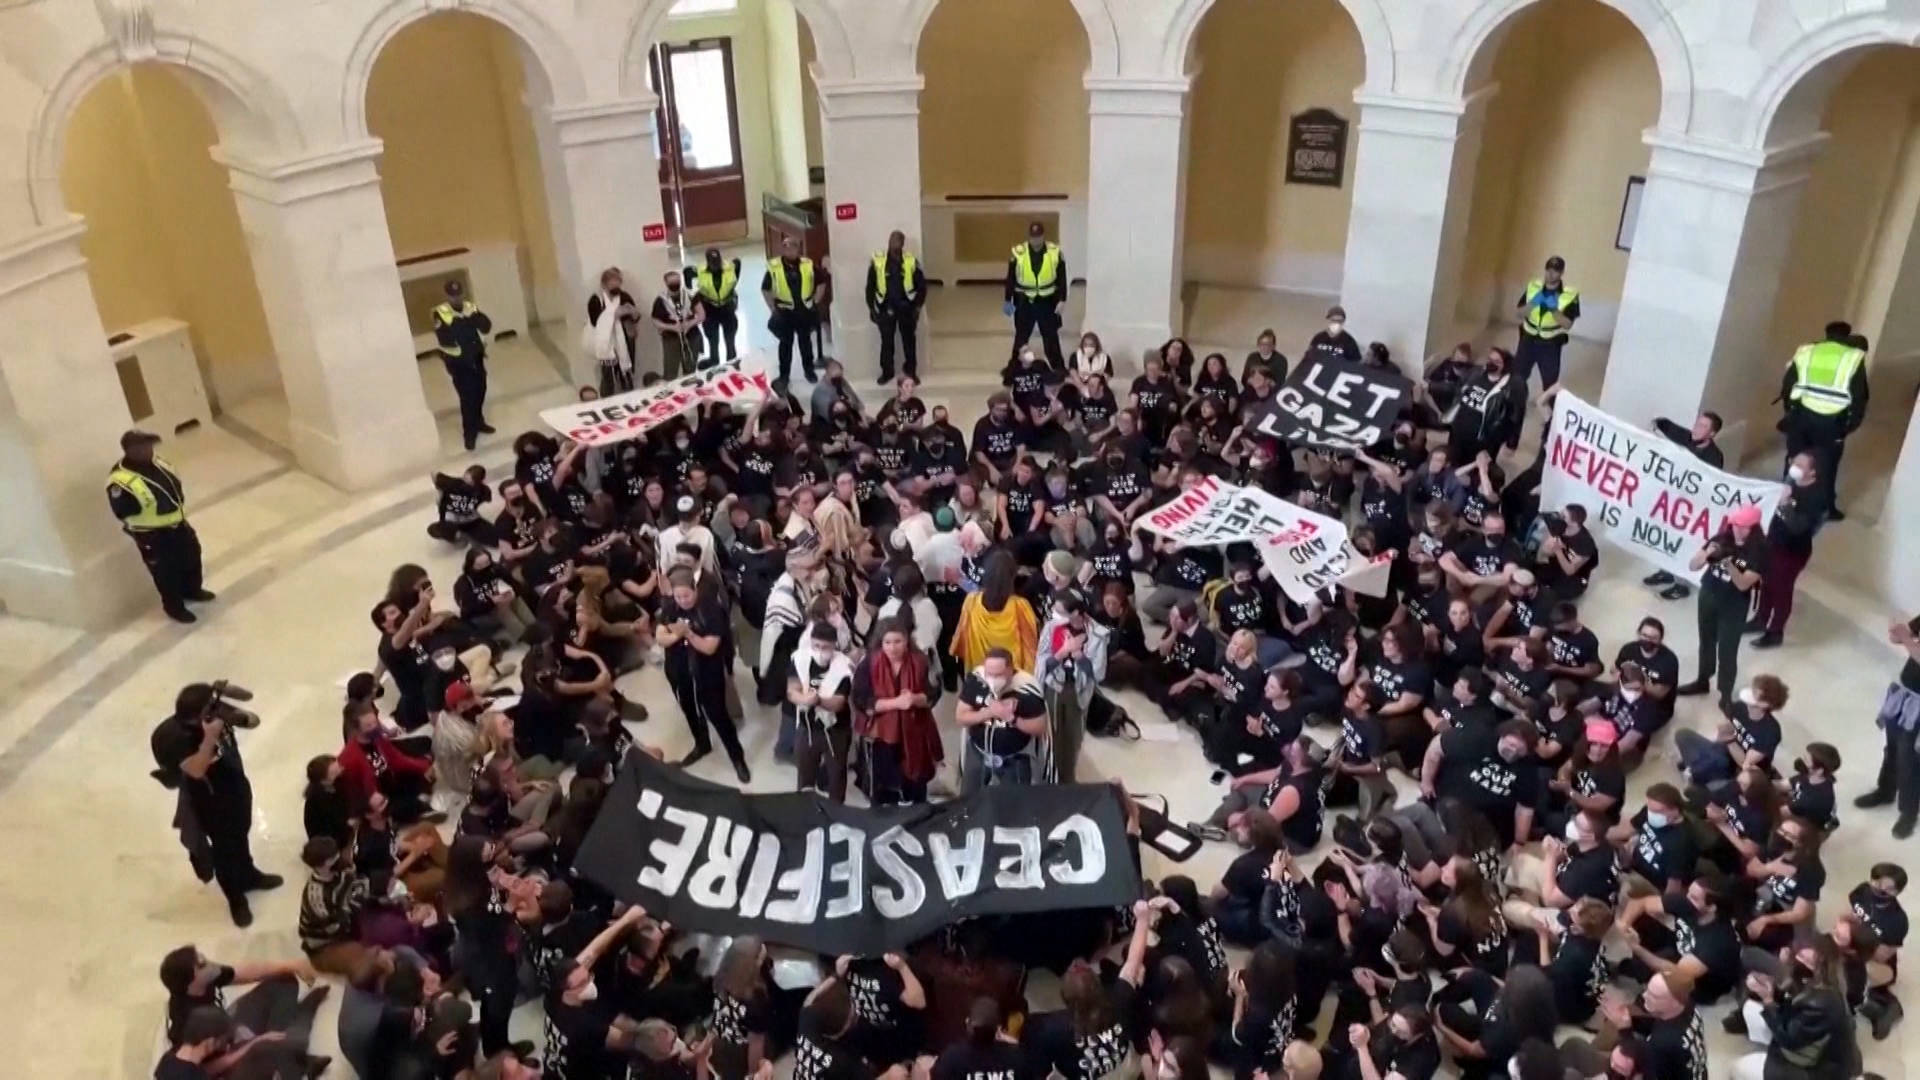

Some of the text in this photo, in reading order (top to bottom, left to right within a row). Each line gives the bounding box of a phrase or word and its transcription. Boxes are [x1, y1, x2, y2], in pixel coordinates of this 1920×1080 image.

[1276, 387, 1381, 446] GAZA
[1302, 362, 1401, 419] LET
[1551, 435, 1640, 508] NEVER
[1564, 409, 1638, 462] PHILLY
[1642, 449, 1703, 495] JEWS
[1150, 477, 1219, 531] LIVING
[1599, 501, 1684, 555] IS NOW
[1288, 536, 1327, 565] AND
[636, 789, 1107, 925] CEASEFIRE.
